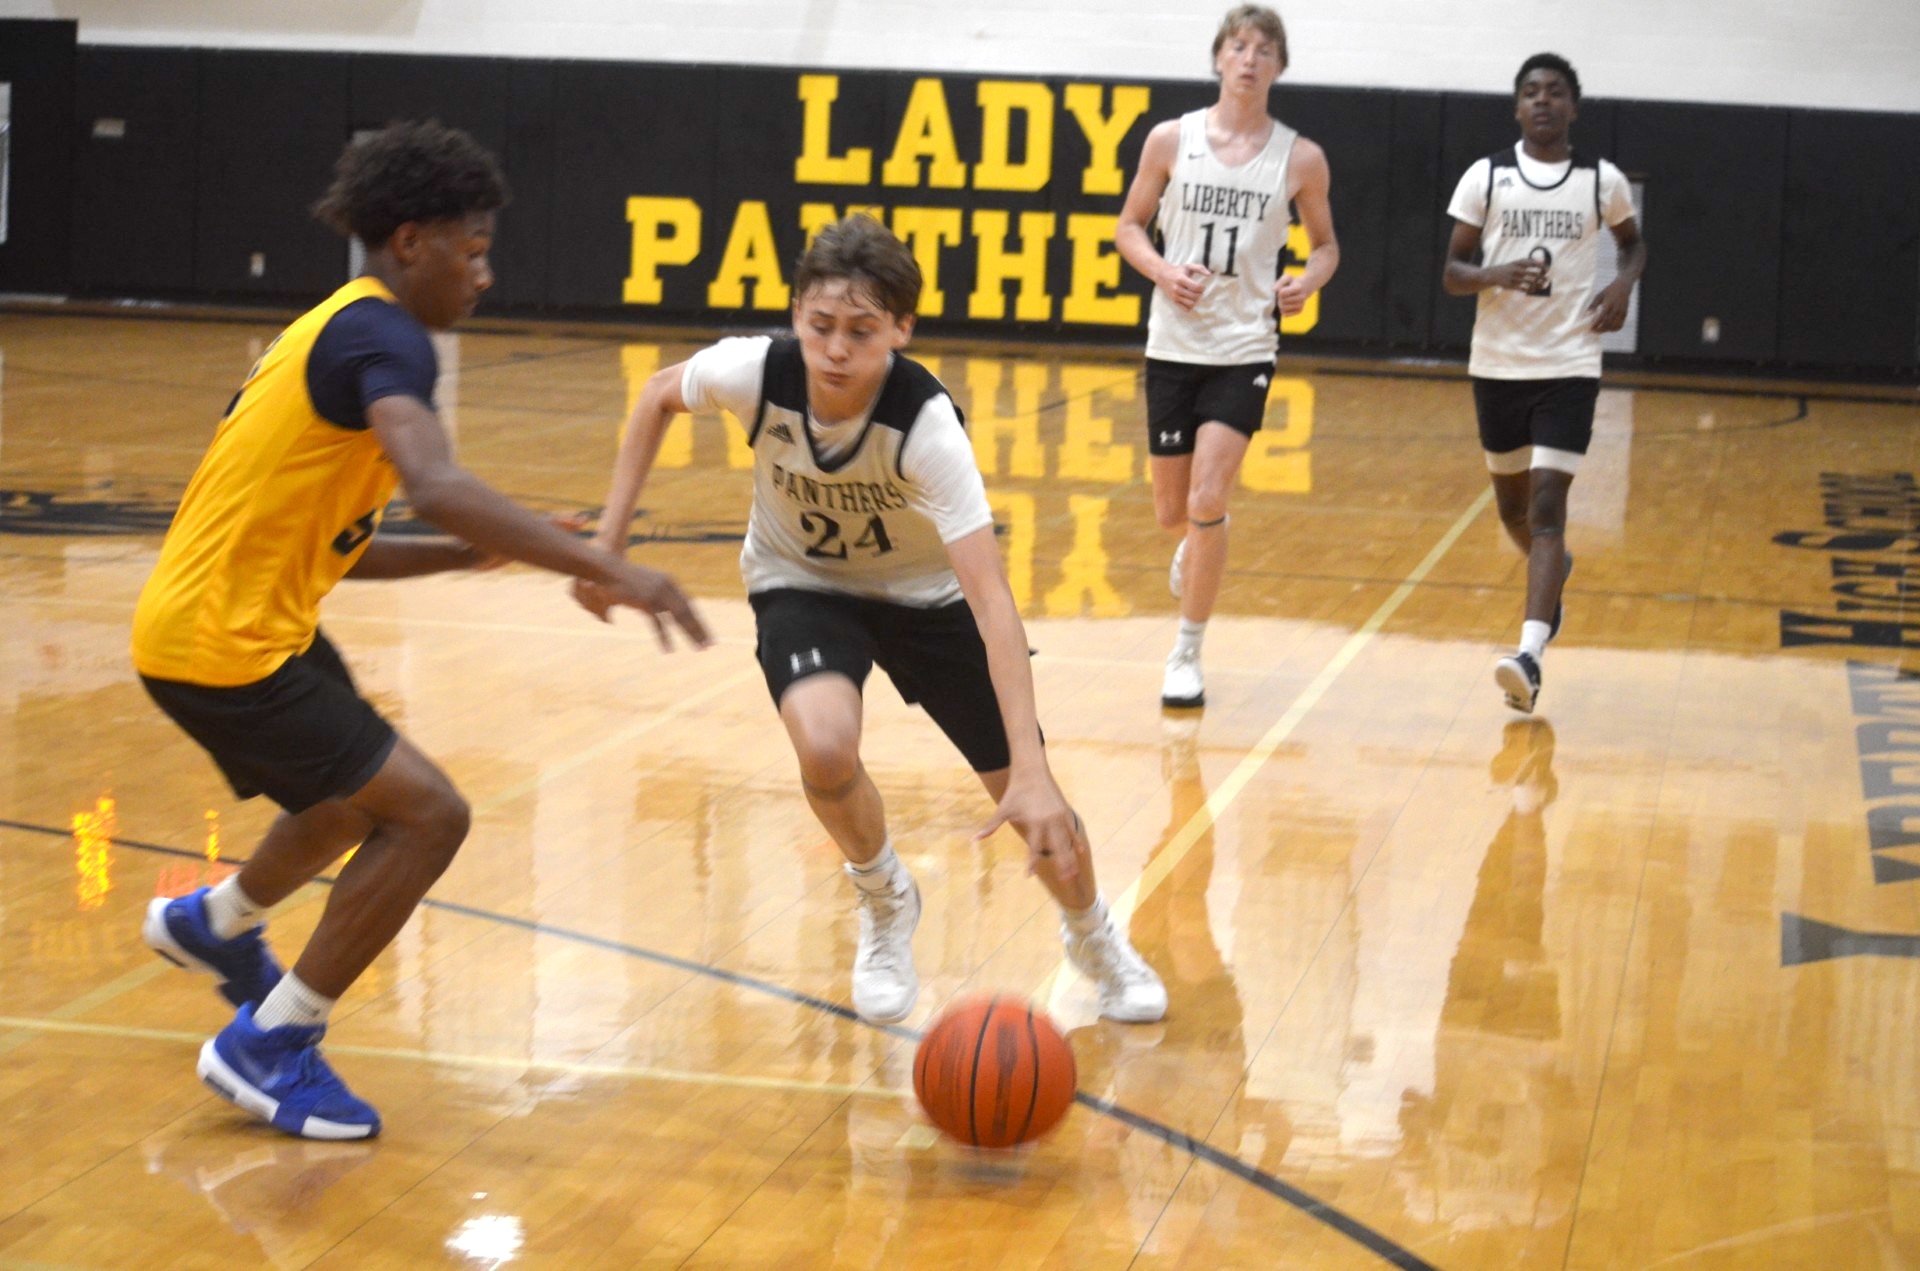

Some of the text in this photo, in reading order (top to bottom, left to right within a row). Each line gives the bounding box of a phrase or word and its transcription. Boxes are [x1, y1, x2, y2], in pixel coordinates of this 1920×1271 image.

[794, 74, 1150, 196] LADY
[1182, 183, 1272, 221] LIBERTY
[1501, 208, 1584, 240] PANTHERS
[1200, 220, 1240, 278] 11
[771, 462, 909, 514] PANTHERS
[800, 510, 896, 561] 24
